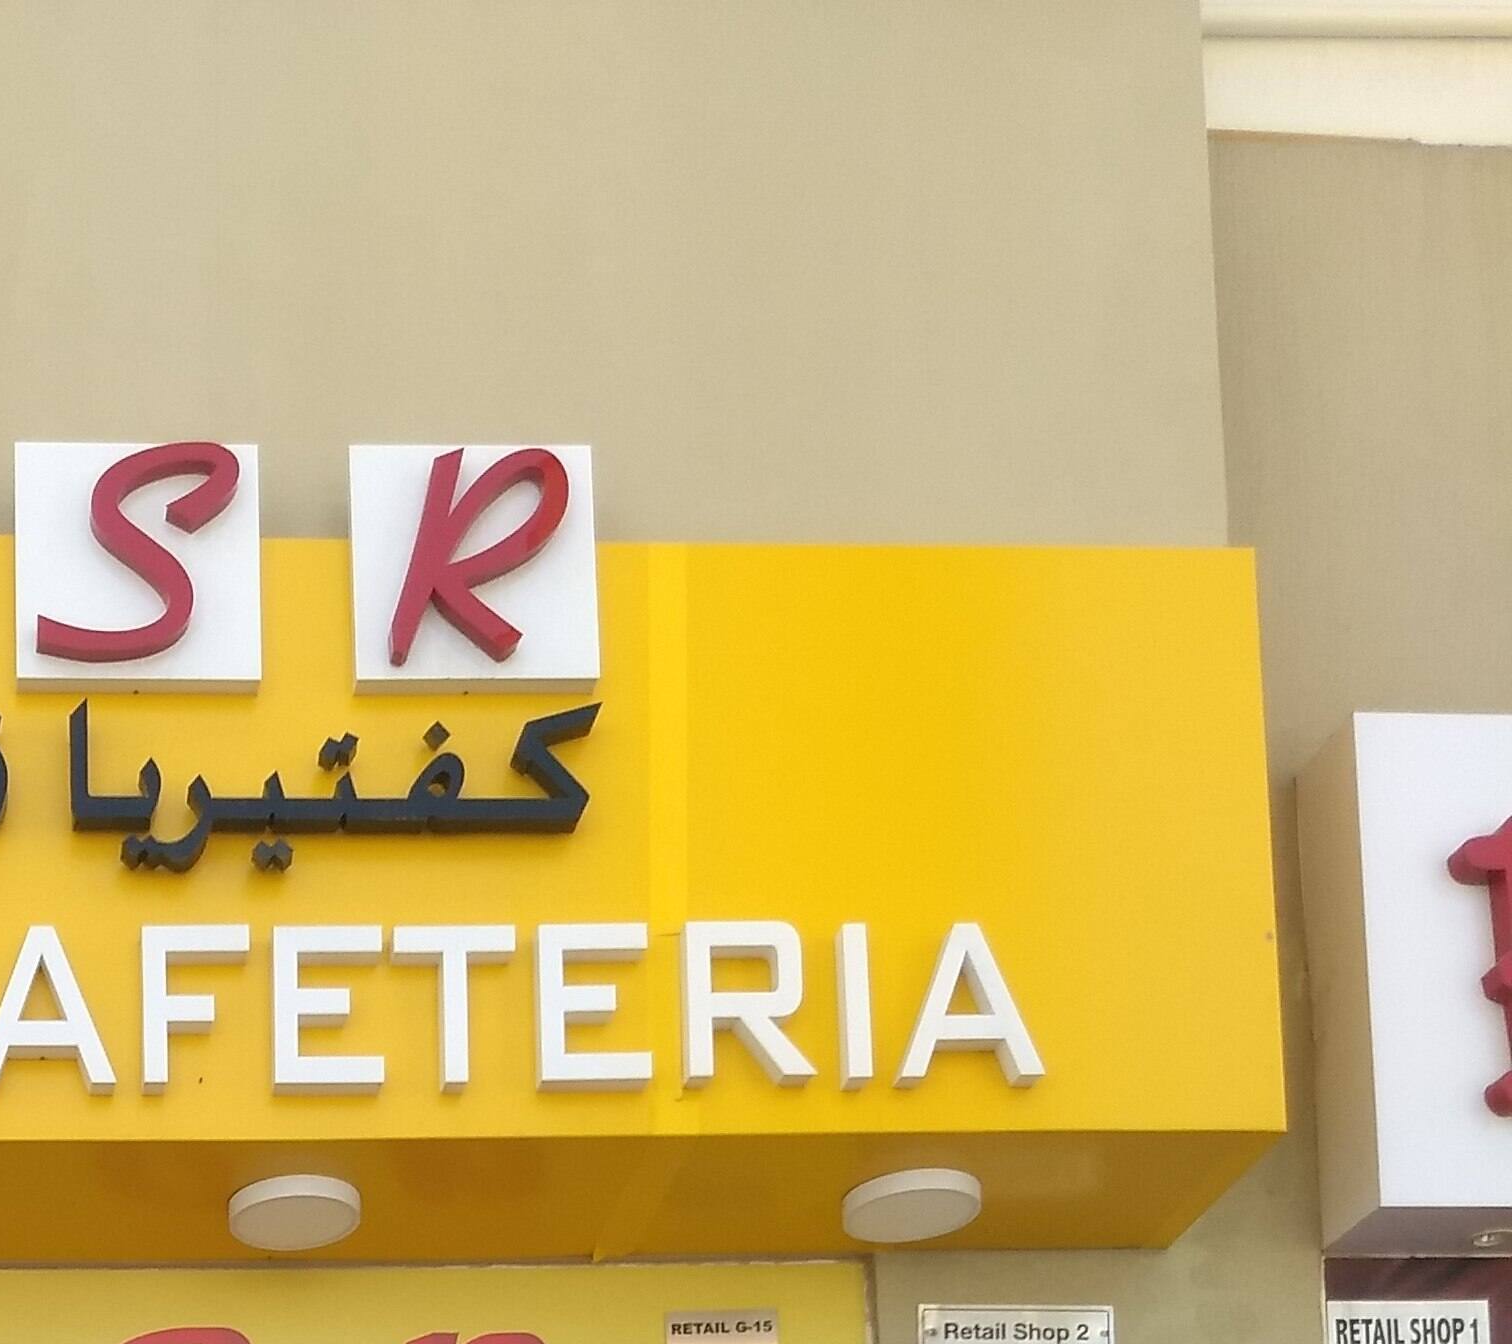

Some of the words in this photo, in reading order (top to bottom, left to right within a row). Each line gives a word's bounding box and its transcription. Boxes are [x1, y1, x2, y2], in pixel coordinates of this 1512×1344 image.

[70, 698, 602, 872] كفتيريا
[671, 1320, 730, 1335] RETAIL
[735, 1319, 773, 1334] G-15
[944, 1323, 1007, 1342] Retail
[1076, 1324, 1089, 1341] 2
[1469, 1317, 1479, 1344] 1
